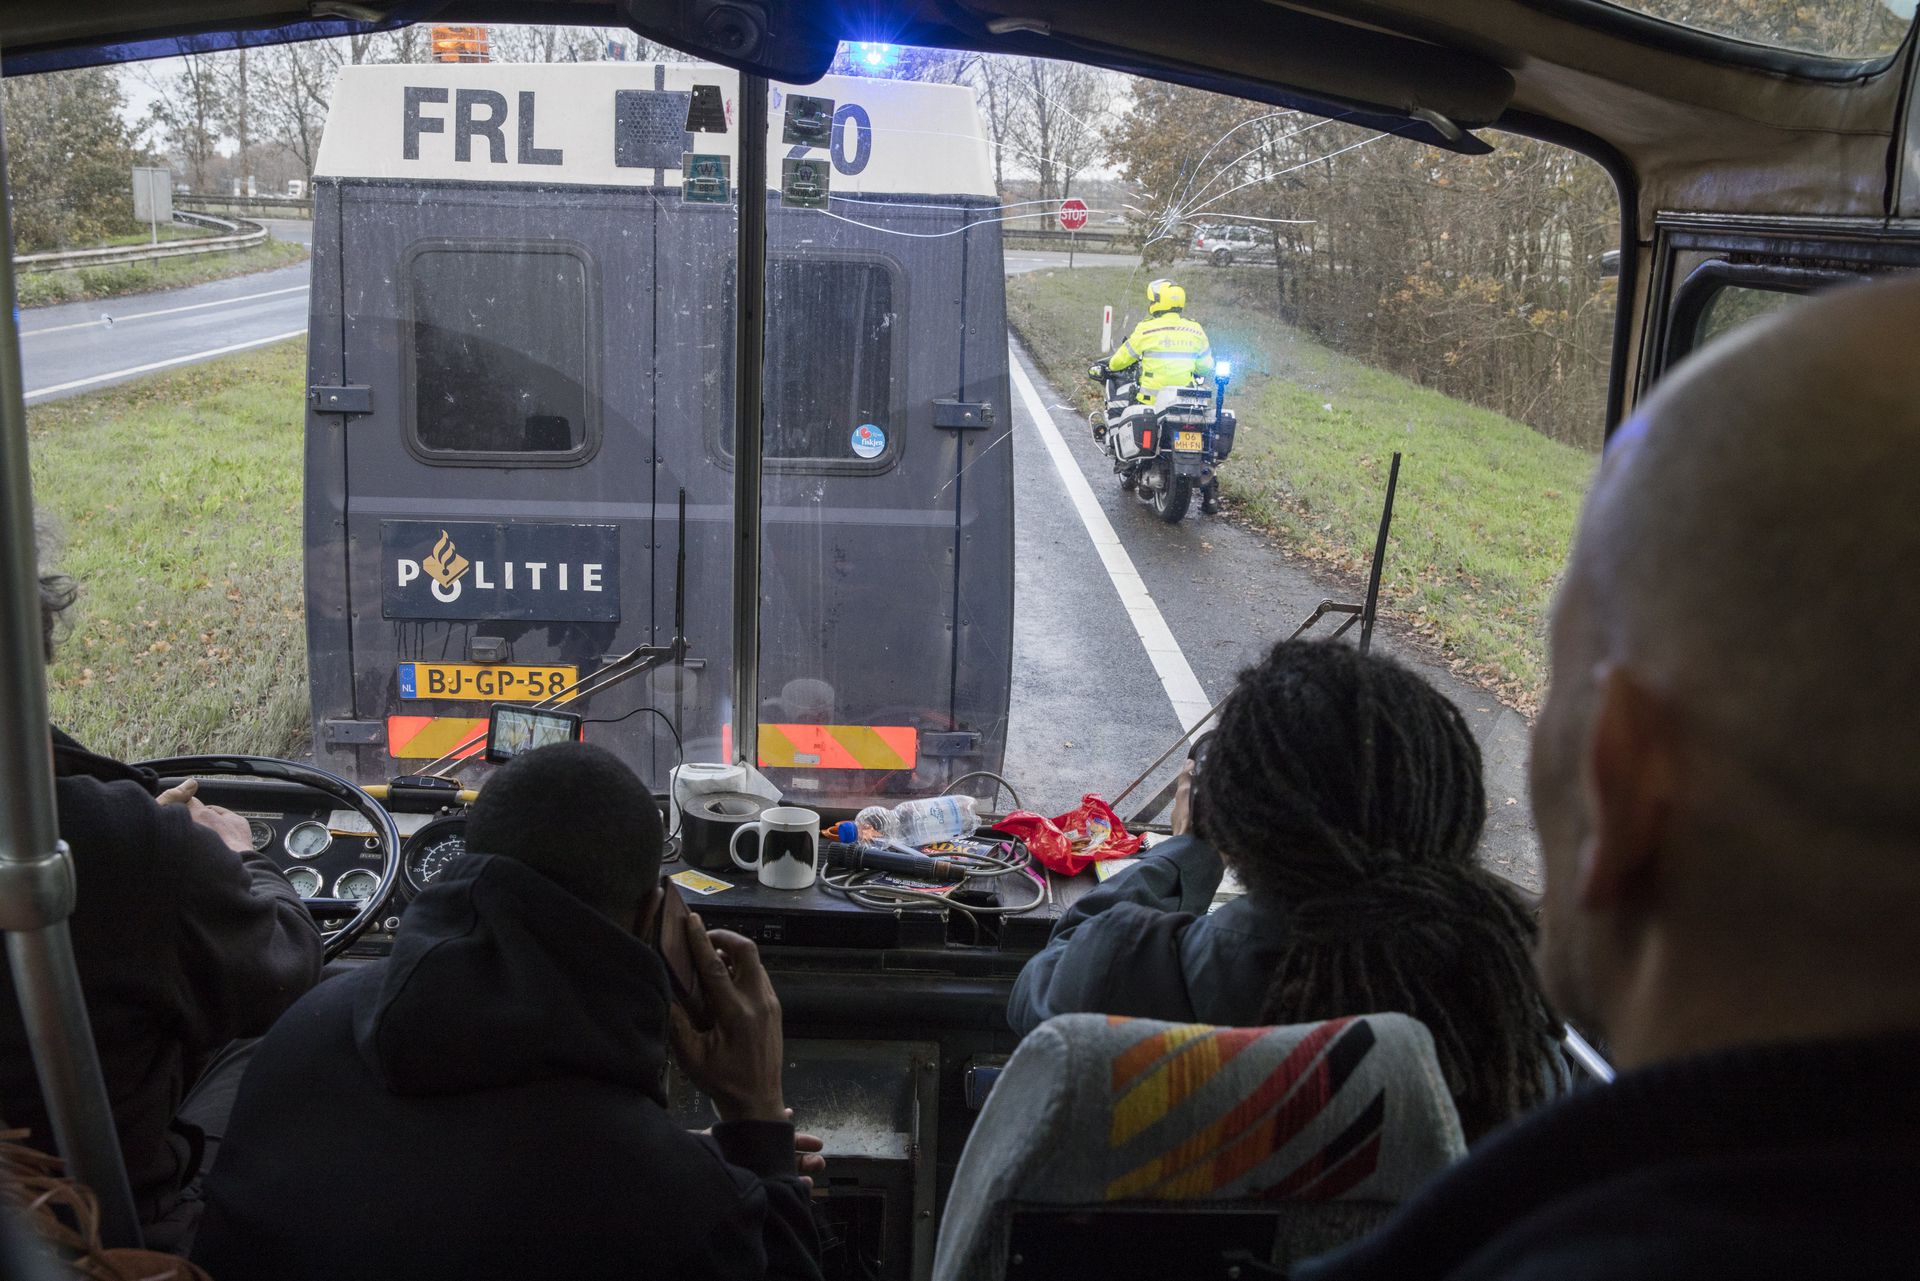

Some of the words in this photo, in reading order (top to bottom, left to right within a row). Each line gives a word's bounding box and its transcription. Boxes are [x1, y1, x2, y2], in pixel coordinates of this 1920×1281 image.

[403, 86, 563, 166] FRL
[1061, 208, 1086, 220] STOP
[1185, 431, 1197, 441] 06
[398, 559, 603, 603] POLITIE
[402, 684, 414, 693] NL
[428, 669, 565, 696] BJ-GP-58
